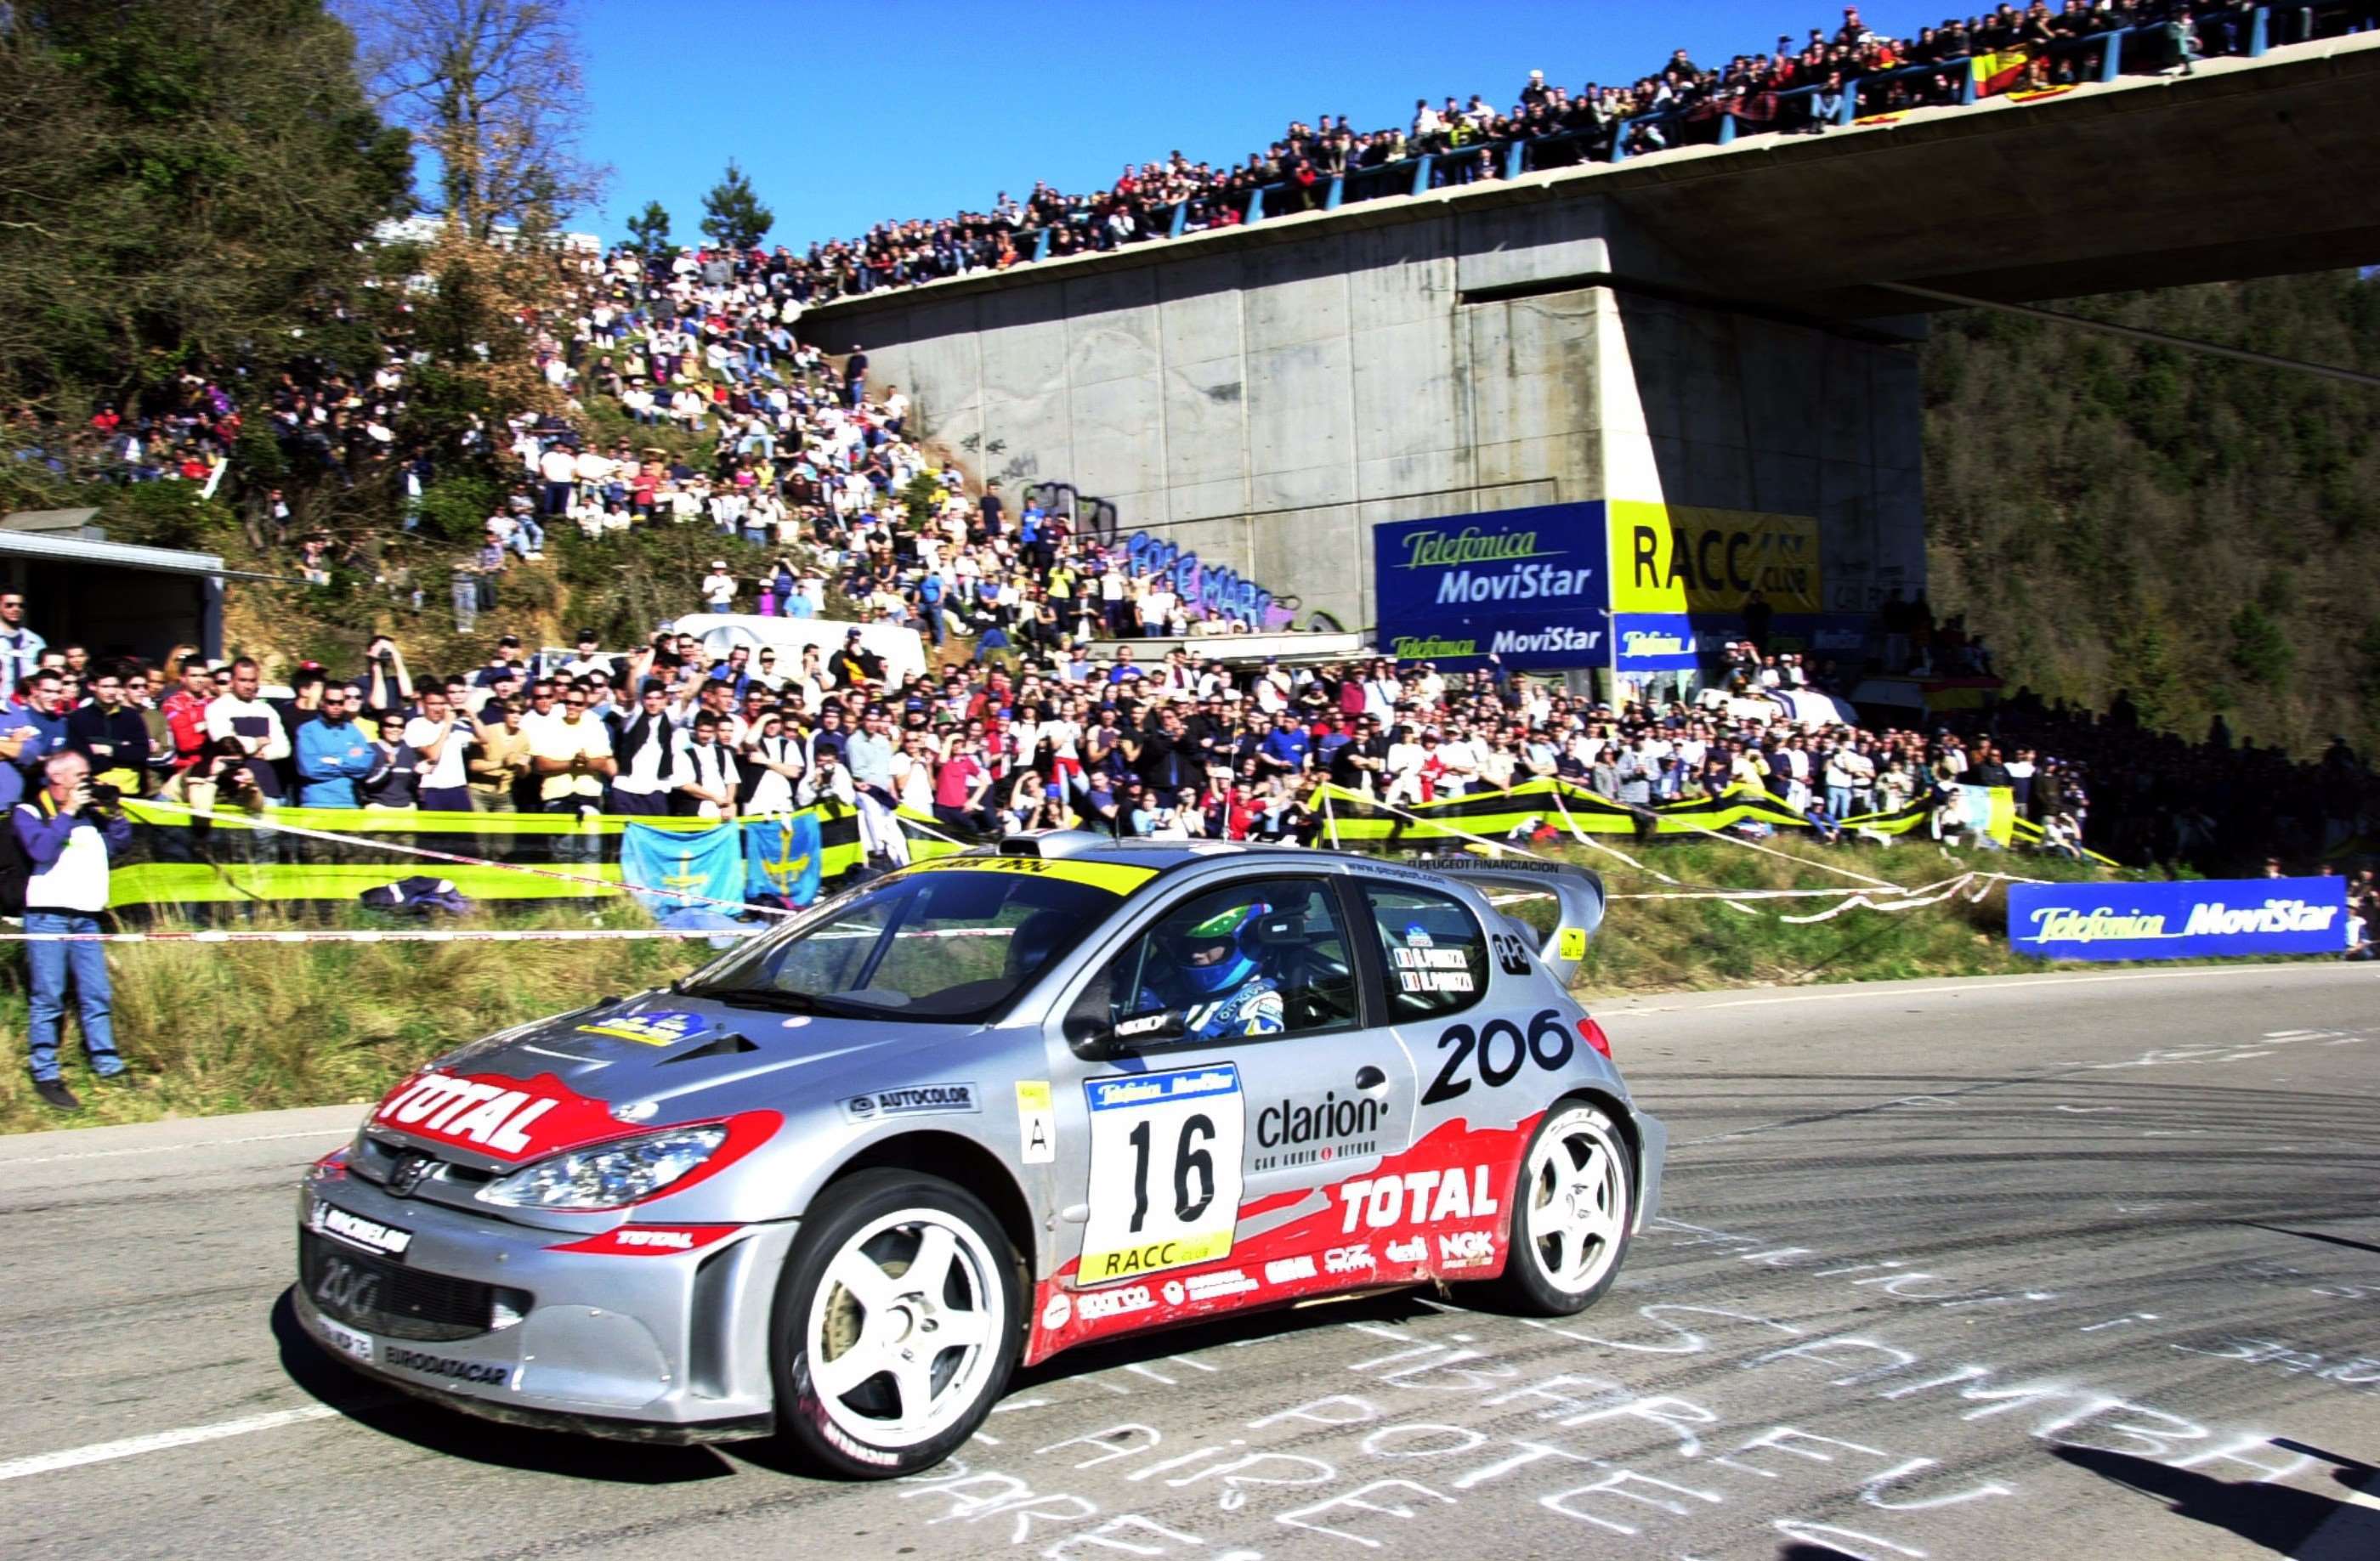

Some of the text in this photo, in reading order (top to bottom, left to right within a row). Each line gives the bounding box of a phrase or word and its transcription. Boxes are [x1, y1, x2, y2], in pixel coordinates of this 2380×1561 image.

[1634, 525, 1754, 592] RACC
[1436, 563, 1592, 604] MoviStar
[1491, 627, 1601, 654] MoviStar
[2183, 899, 2338, 936] MoviStar
[1421, 1010, 1574, 1106] 206
[379, 1072, 560, 1155] TOTAL
[878, 1086, 971, 1108] AUTOCOLOR
[1029, 1117, 1047, 1151] A
[1129, 1112, 1216, 1233] 16
[1340, 1163, 1499, 1233] TOTAL
[616, 1230, 695, 1249] TOTAL
[1104, 1241, 1176, 1276] RACC
[1438, 1230, 1495, 1259] NGK
[385, 1345, 509, 1386] EURODATACAR
